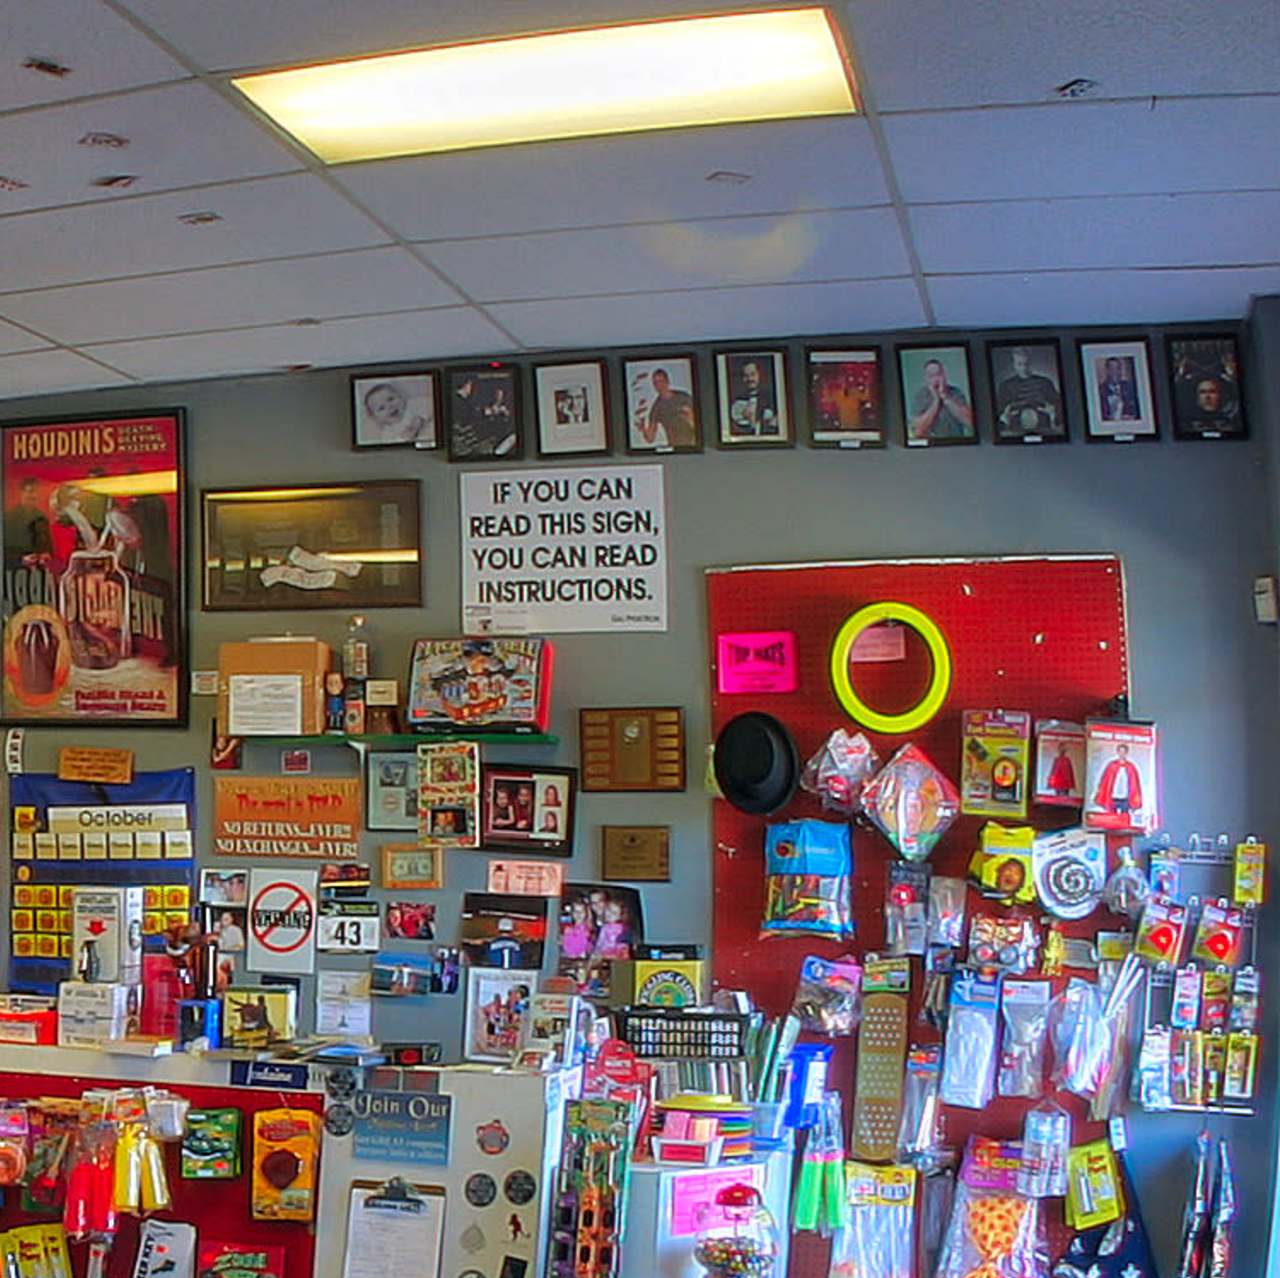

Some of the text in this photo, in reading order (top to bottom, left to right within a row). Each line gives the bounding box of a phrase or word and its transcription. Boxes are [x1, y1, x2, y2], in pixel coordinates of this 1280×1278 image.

[493, 477, 632, 504] IF YOU CAN
[470, 510, 659, 537] READ THIS SIGN,
[472, 544, 657, 570] YOU CAN READ
[479, 578, 653, 603] INSTRUCTIONS.
[79, 810, 153, 828] October
[334, 920, 362, 945] 43
[352, 1093, 448, 1119] Join Our
